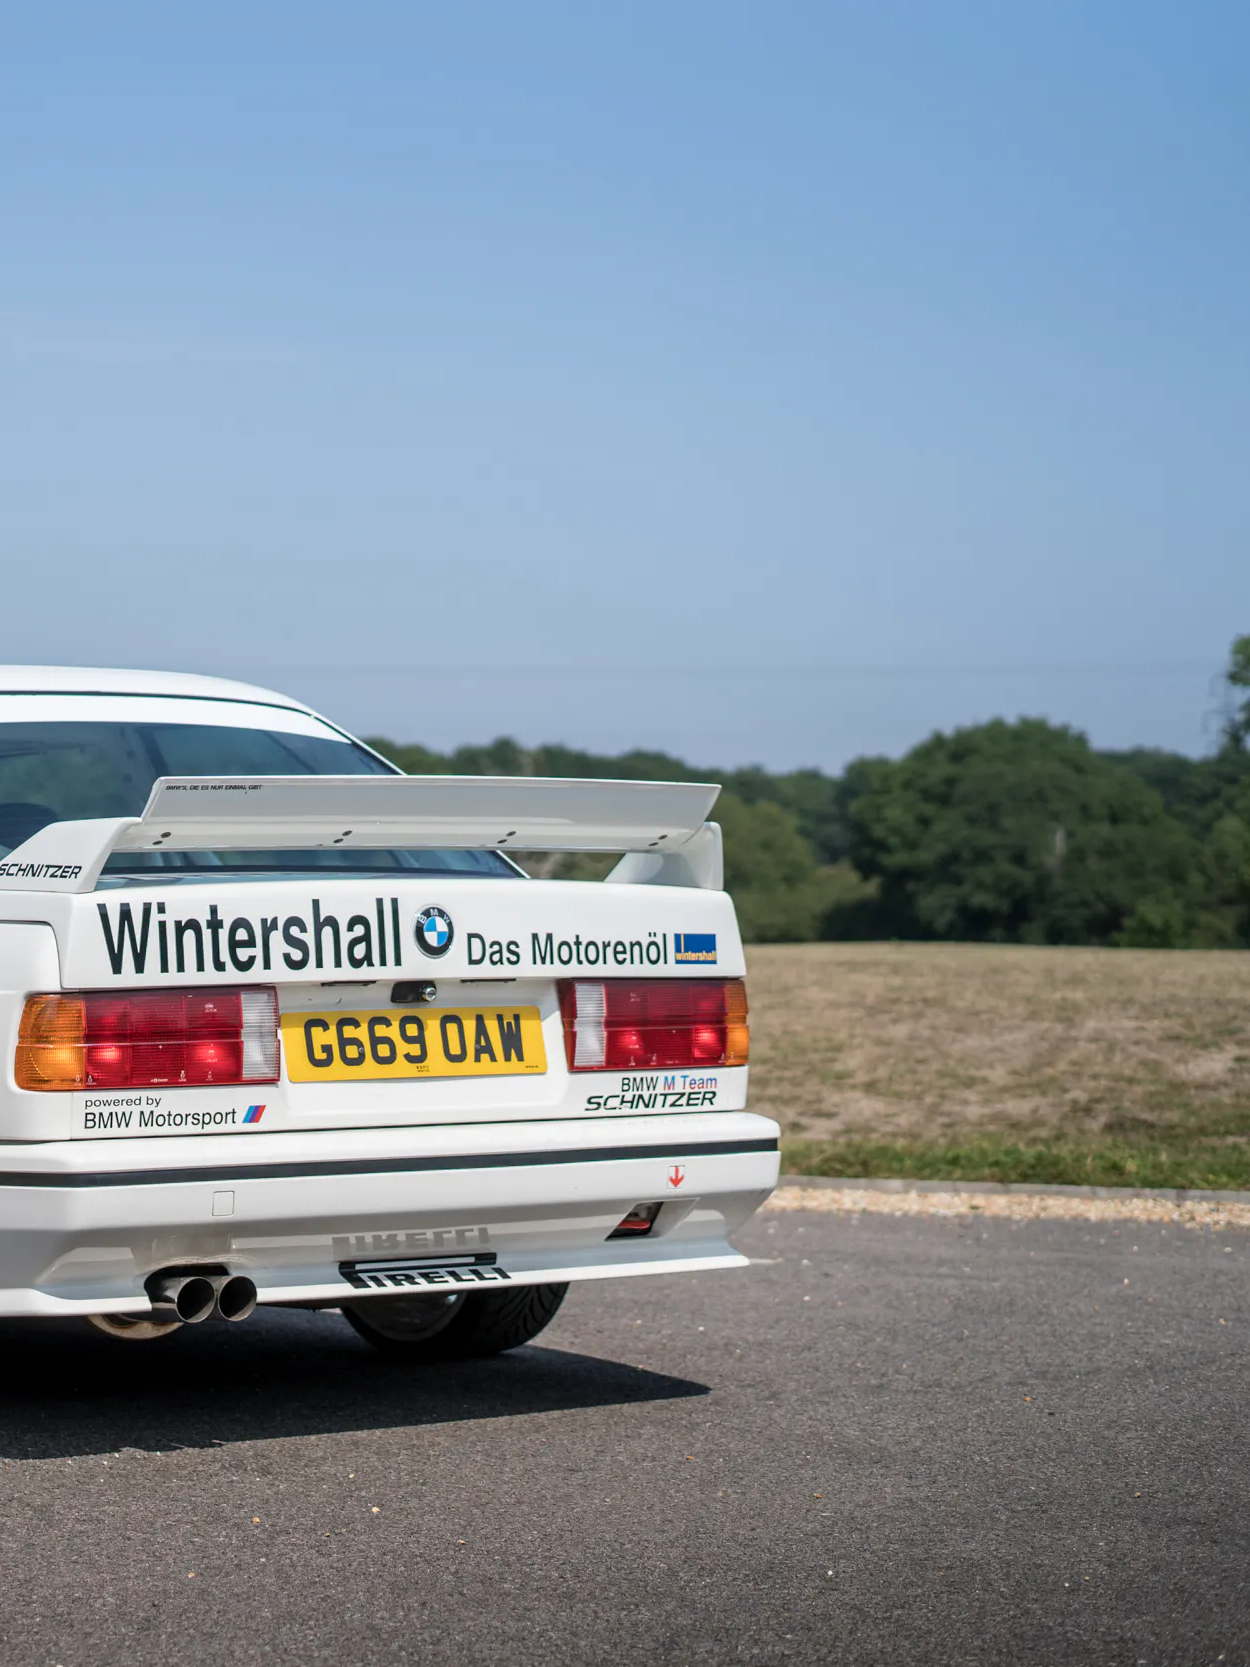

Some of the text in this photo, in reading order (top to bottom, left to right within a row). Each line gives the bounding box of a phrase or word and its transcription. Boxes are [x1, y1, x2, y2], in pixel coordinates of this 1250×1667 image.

[418, 909, 450, 924] BMW
[96, 897, 402, 975] Wintershall
[467, 932, 668, 966] Das Motorenöl
[675, 950, 717, 961] wintershall
[304, 1013, 524, 1068] G669 OAW
[621, 1075, 717, 1092] BMW M Team
[84, 1095, 162, 1108] powered by
[585, 1091, 716, 1111] SCHNITZER
[84, 1109, 237, 1132] BMW Motorsport
[338, 1252, 512, 1289] PIRELLI
